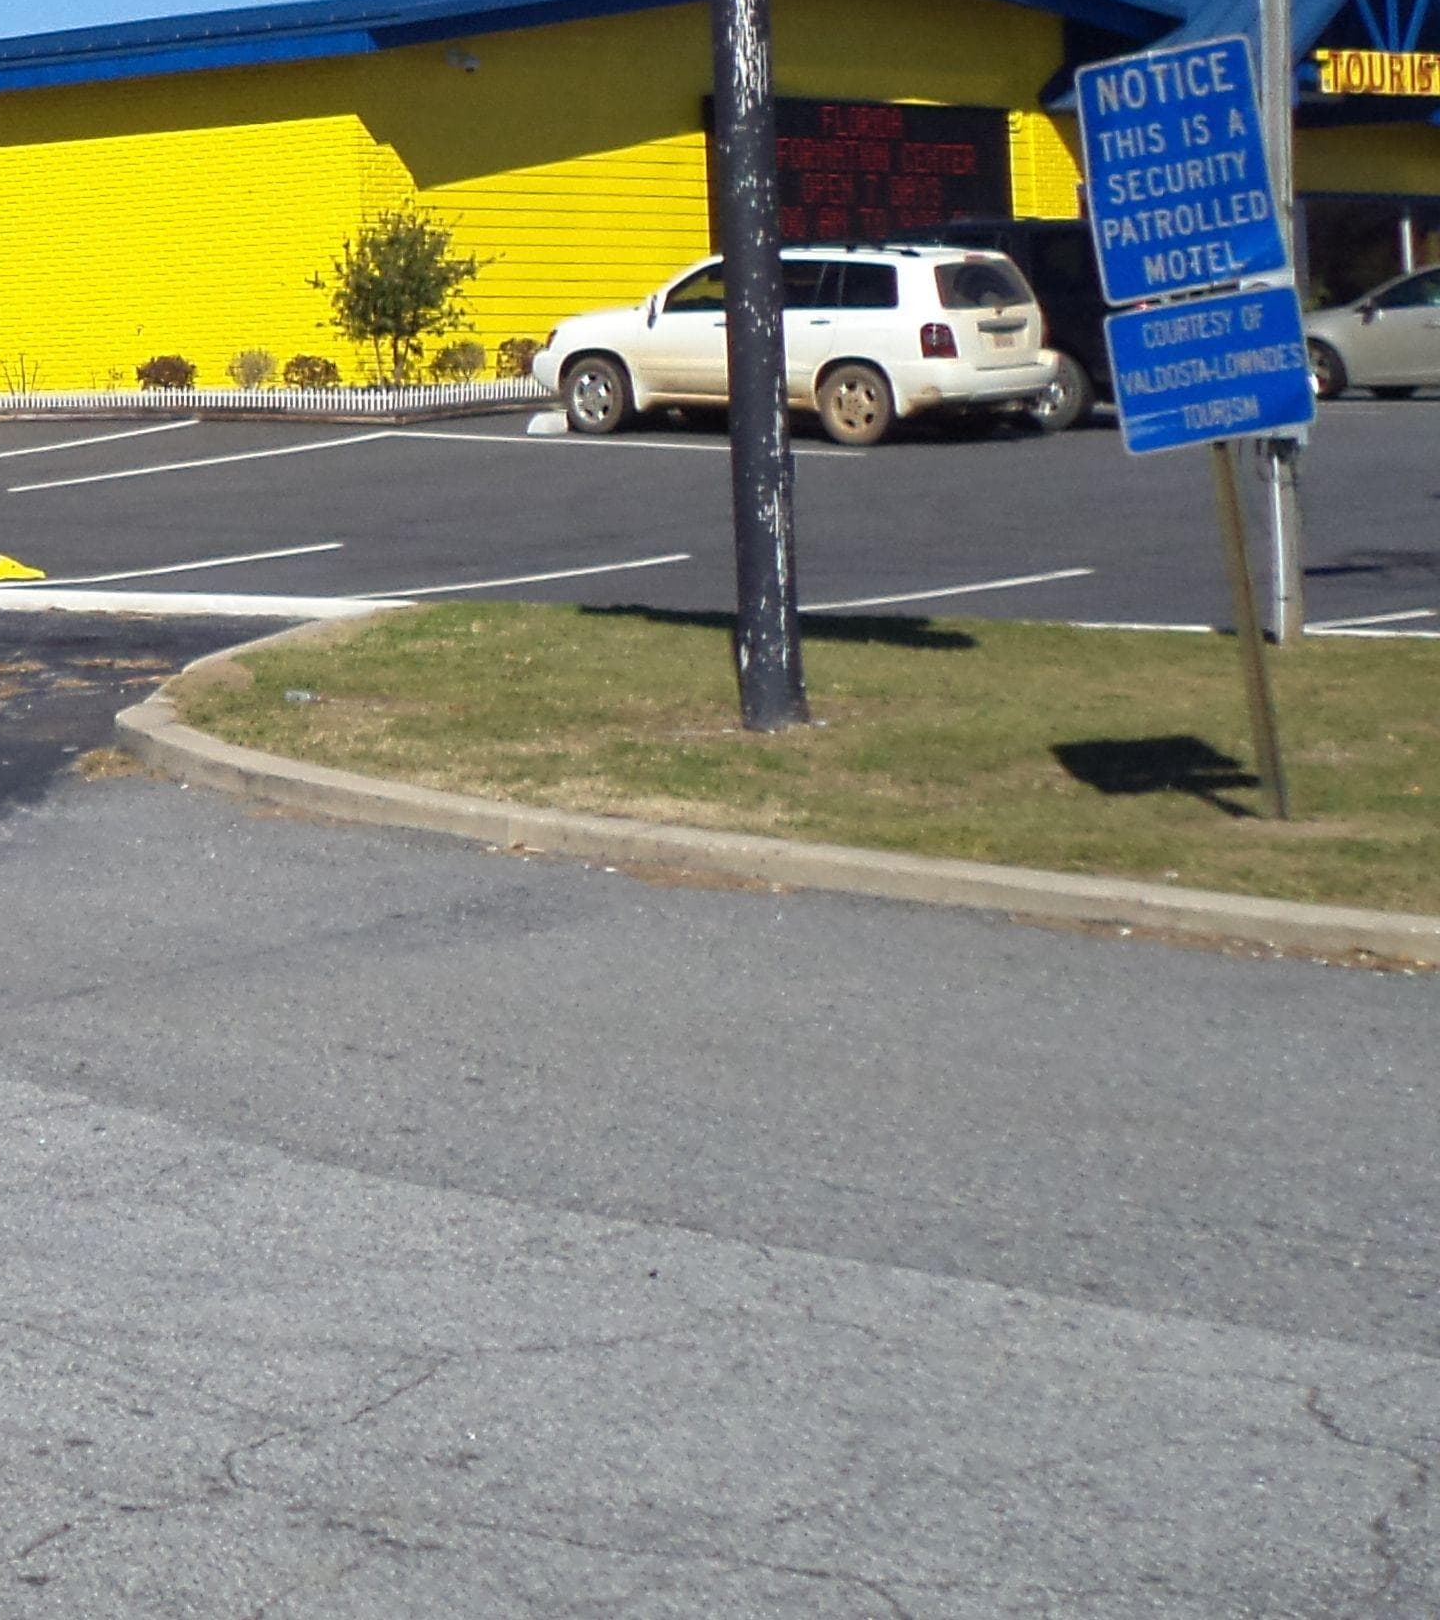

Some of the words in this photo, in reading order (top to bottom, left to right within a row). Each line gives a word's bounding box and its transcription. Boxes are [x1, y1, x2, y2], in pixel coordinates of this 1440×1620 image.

[1096, 51, 1235, 116] NOTICE
[1328, 50, 1440, 93] TOURIS
[1098, 123, 1167, 162] THIS
[1181, 113, 1211, 147] IS
[1228, 108, 1248, 139] A
[1107, 150, 1248, 205] SECURITY
[1102, 190, 1268, 250] PATROLLED
[1143, 240, 1246, 285] MOTEL
[1142, 308, 1234, 348] COURTESY
[1240, 303, 1263, 332] OF
[1120, 343, 1305, 395] VALDOSTA-LOWNDES
[1182, 395, 1260, 430] TOURISM
